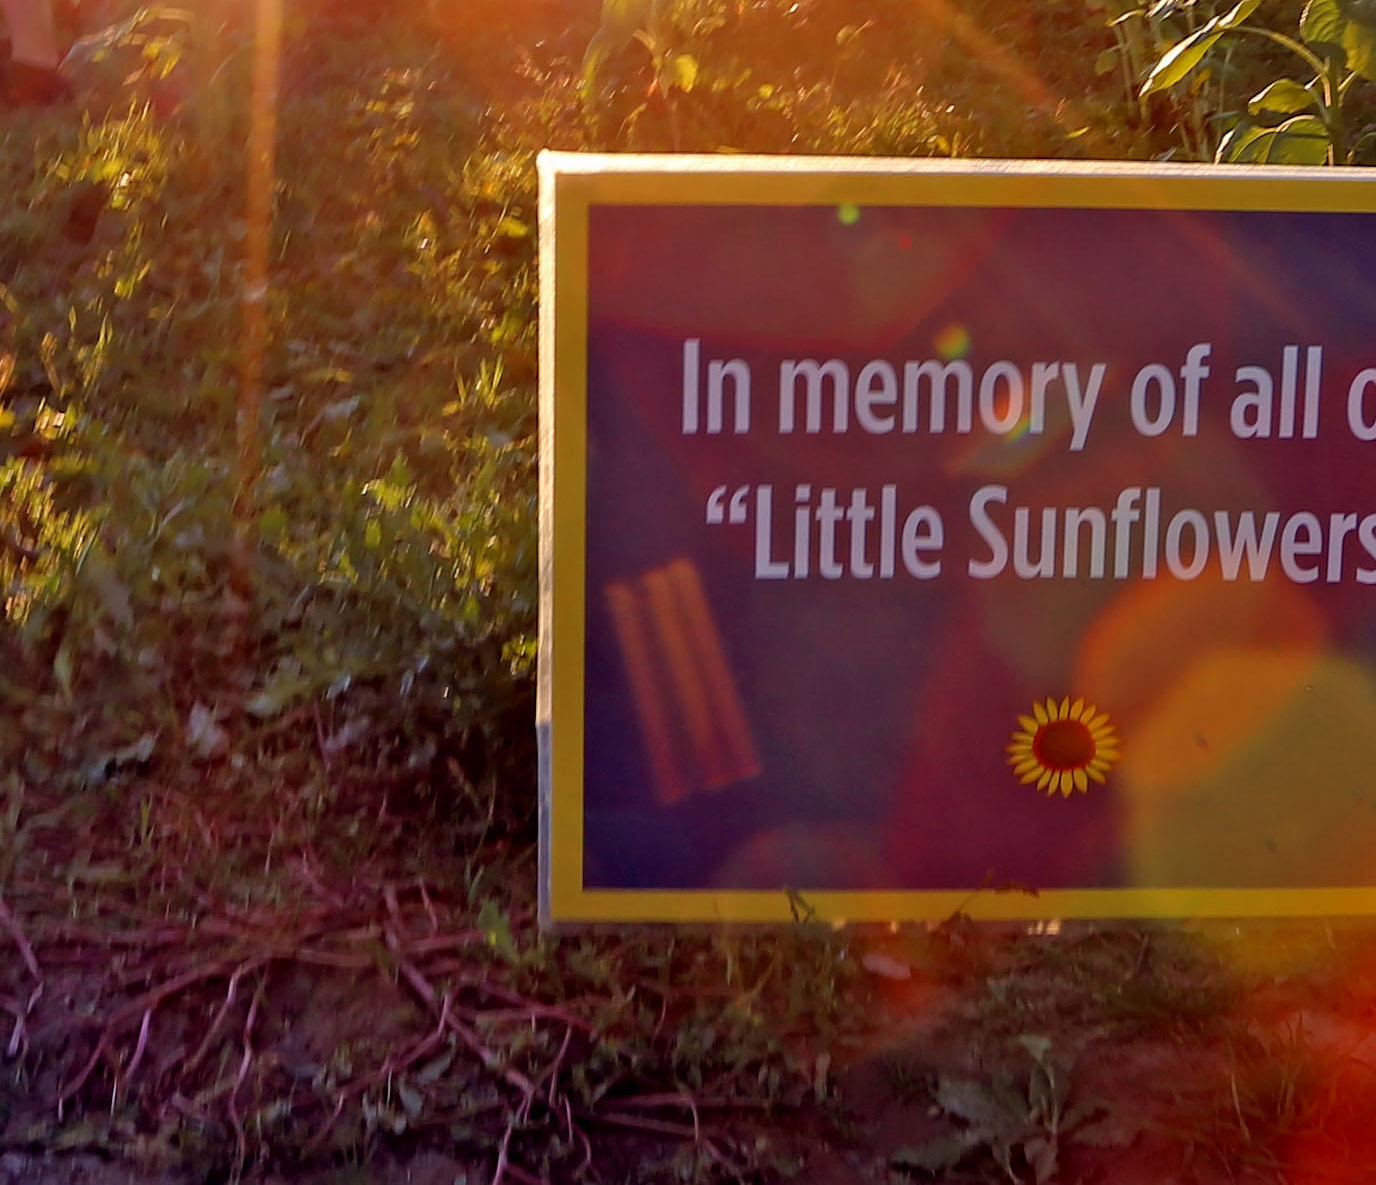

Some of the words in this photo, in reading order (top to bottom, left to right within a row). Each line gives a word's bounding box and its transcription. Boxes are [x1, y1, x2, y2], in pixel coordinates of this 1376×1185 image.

[682, 338, 751, 434] In
[778, 359, 1107, 451] memory
[1130, 343, 1212, 437] of
[1230, 345, 1323, 439] all
[705, 484, 944, 579] “Little
